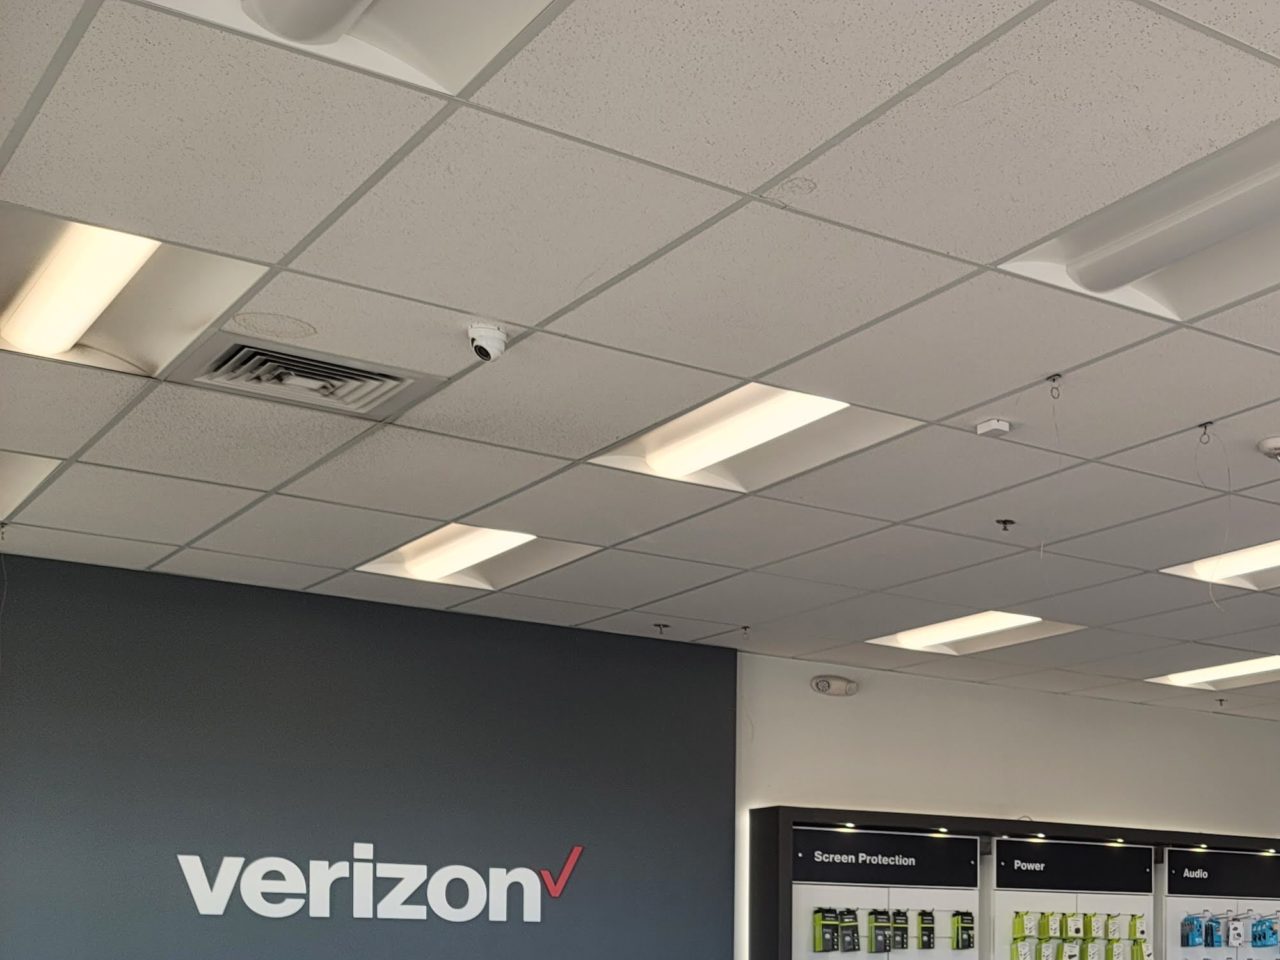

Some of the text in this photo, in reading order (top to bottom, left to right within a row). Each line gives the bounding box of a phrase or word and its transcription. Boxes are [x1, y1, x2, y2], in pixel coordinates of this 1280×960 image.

[814, 851, 916, 866] Screen Protection
[1014, 859, 1046, 871] Power
[1183, 868, 1208, 879] Audio
[177, 842, 541, 922] verizon
